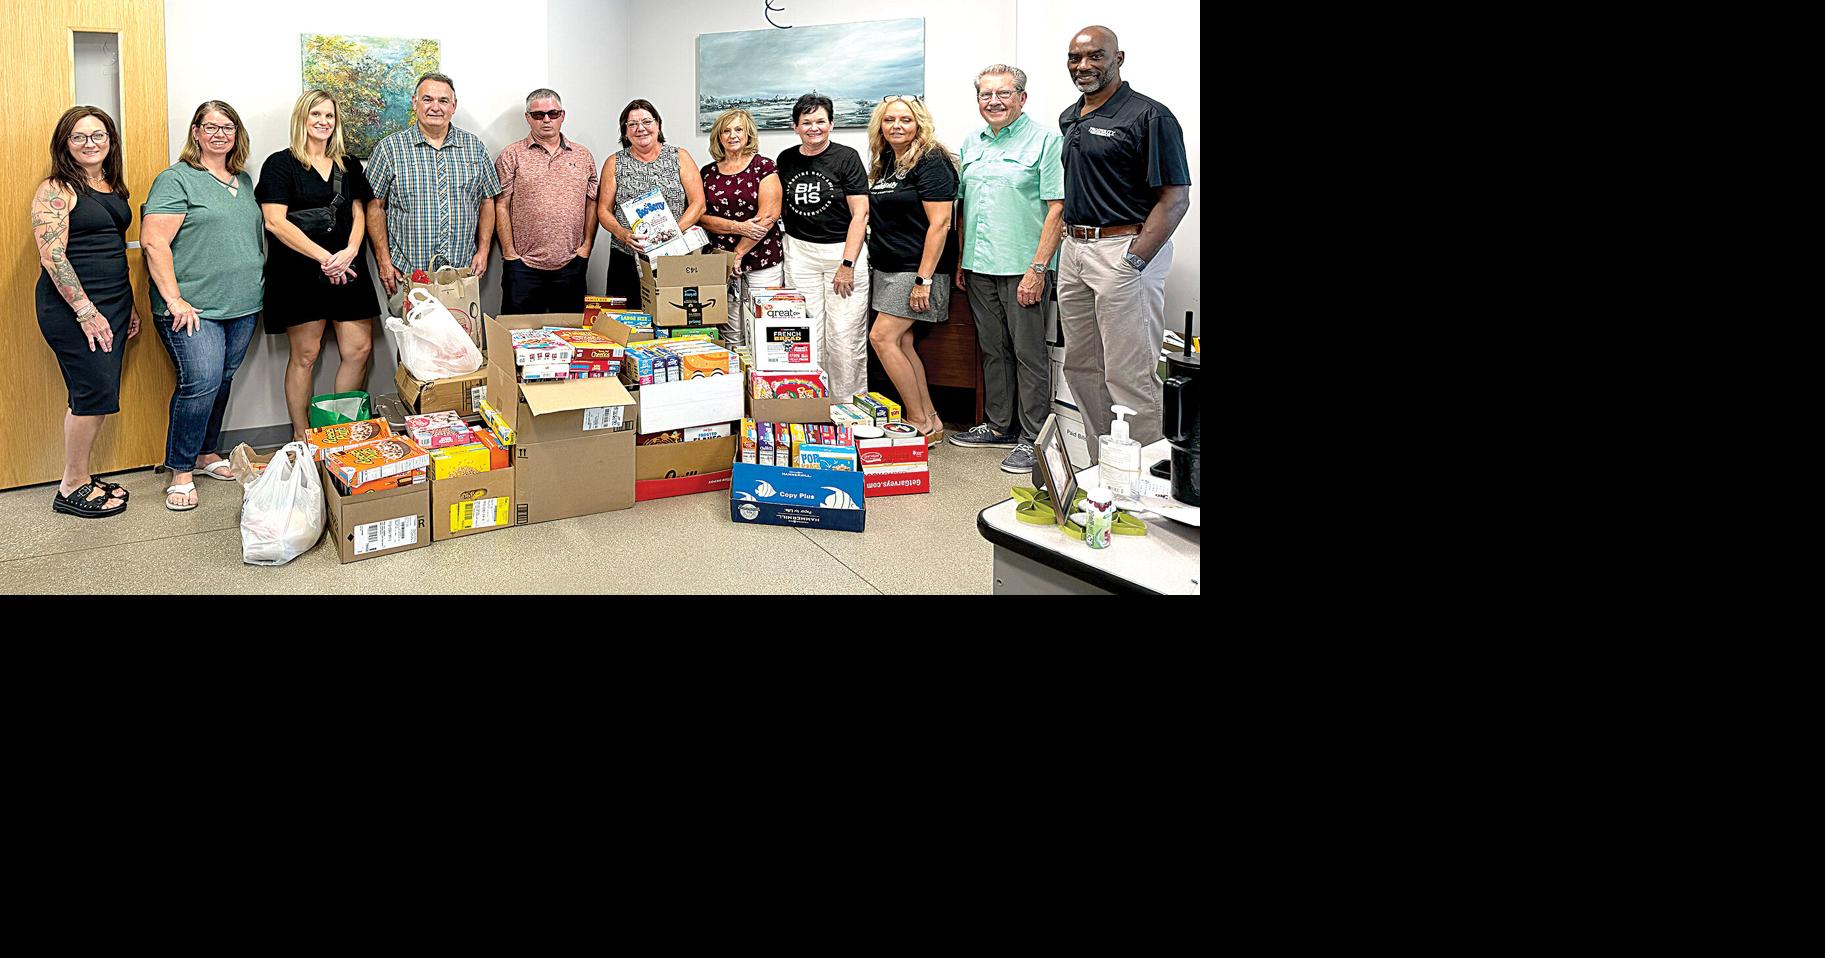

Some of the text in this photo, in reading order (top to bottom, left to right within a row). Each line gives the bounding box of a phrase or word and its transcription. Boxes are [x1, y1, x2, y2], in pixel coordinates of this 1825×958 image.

[795, 181, 820, 193] BH
[794, 192, 820, 205] HS
[685, 266, 699, 274] 143
[801, 453, 819, 463] POP
[866, 478, 921, 489] GetGarveys.com
[779, 491, 815, 500] Copy Plus
[776, 514, 820, 522] HAMMERMILL
